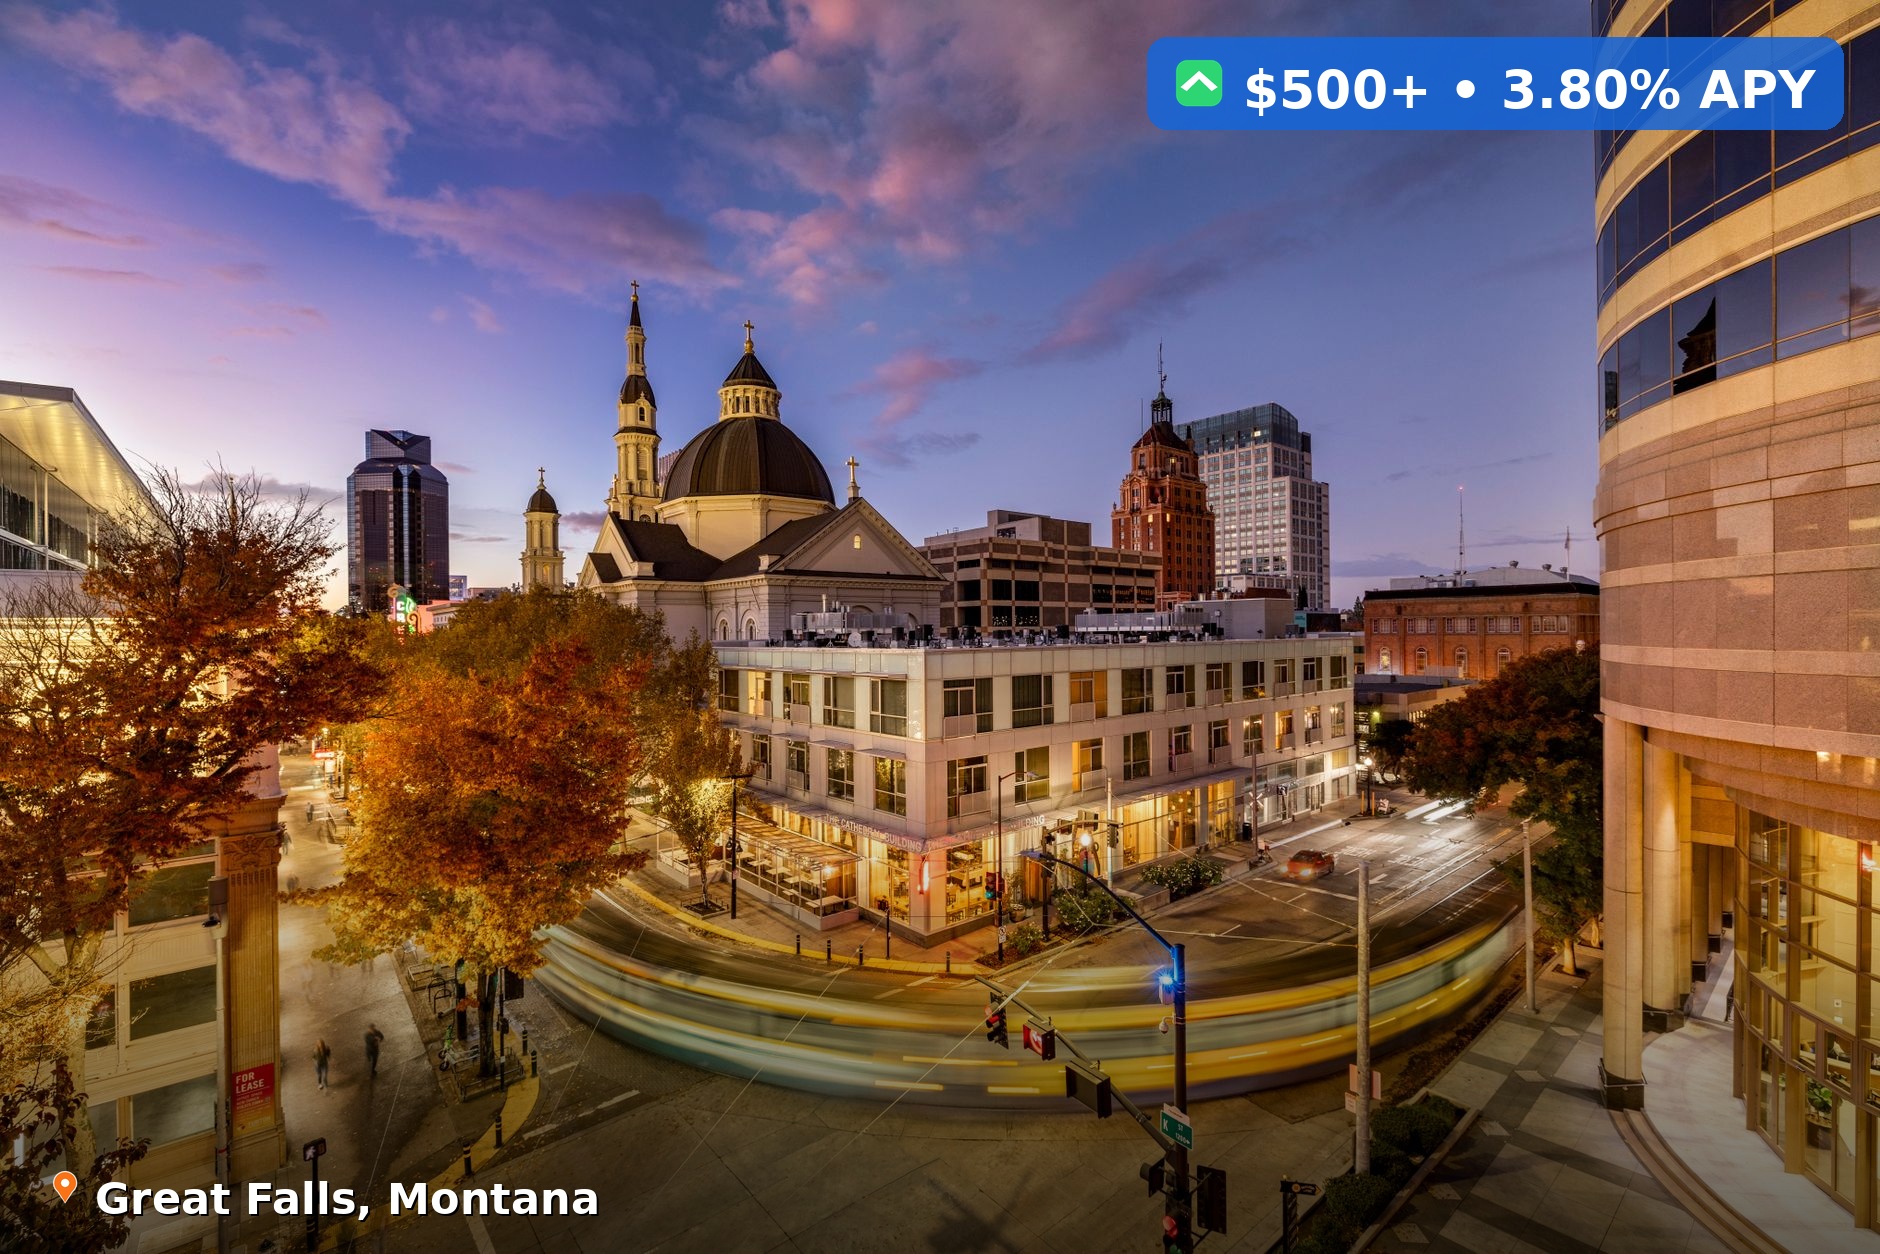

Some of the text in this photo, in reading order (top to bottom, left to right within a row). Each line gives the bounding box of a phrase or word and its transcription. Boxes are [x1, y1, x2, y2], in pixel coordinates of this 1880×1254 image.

[885, 832, 922, 852] BUILDING
[235, 1071, 255, 1085] FOR
[235, 1078, 265, 1094] LEASE
[1163, 1118, 1169, 1131] K
